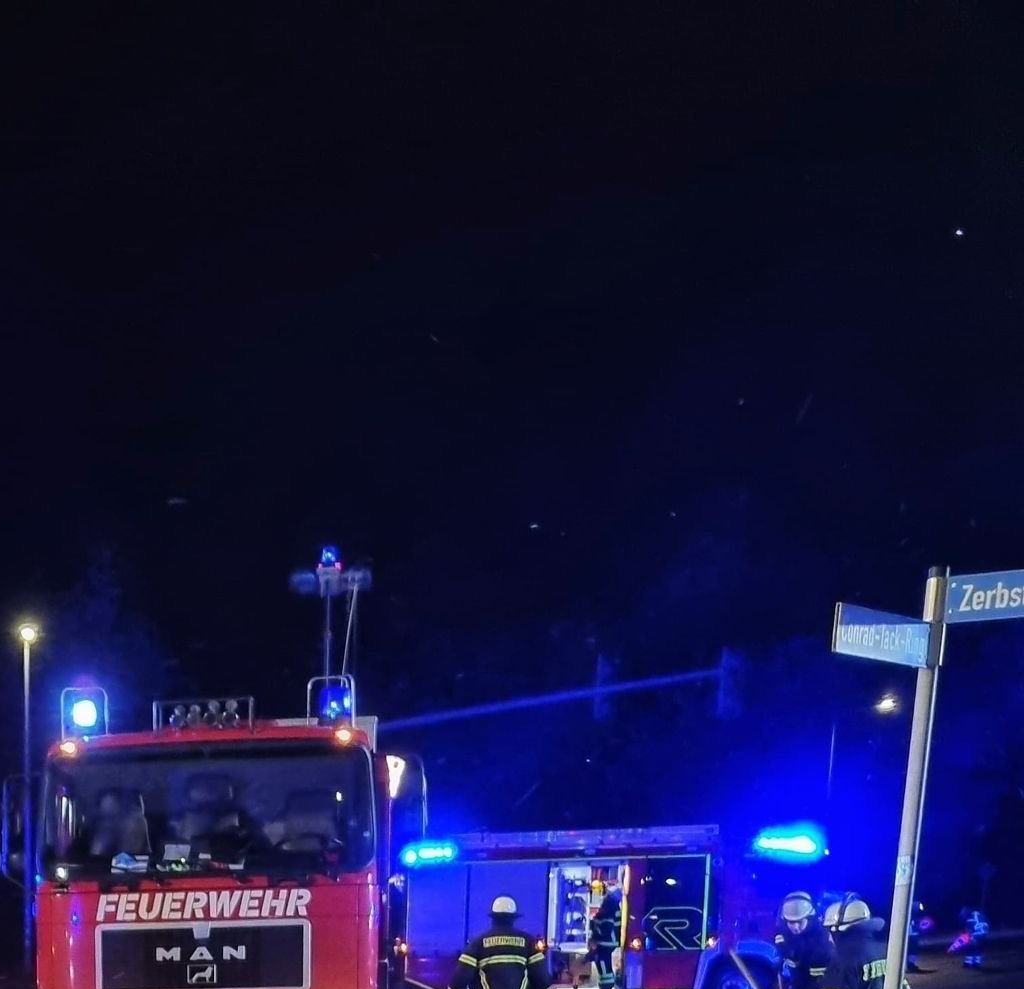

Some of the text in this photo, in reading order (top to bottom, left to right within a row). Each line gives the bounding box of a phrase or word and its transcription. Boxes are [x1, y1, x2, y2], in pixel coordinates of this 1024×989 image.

[959, 581, 1024, 611] Zerbs
[96, 888, 311, 921] FEUERWEHR
[156, 946, 245, 961] MAN
